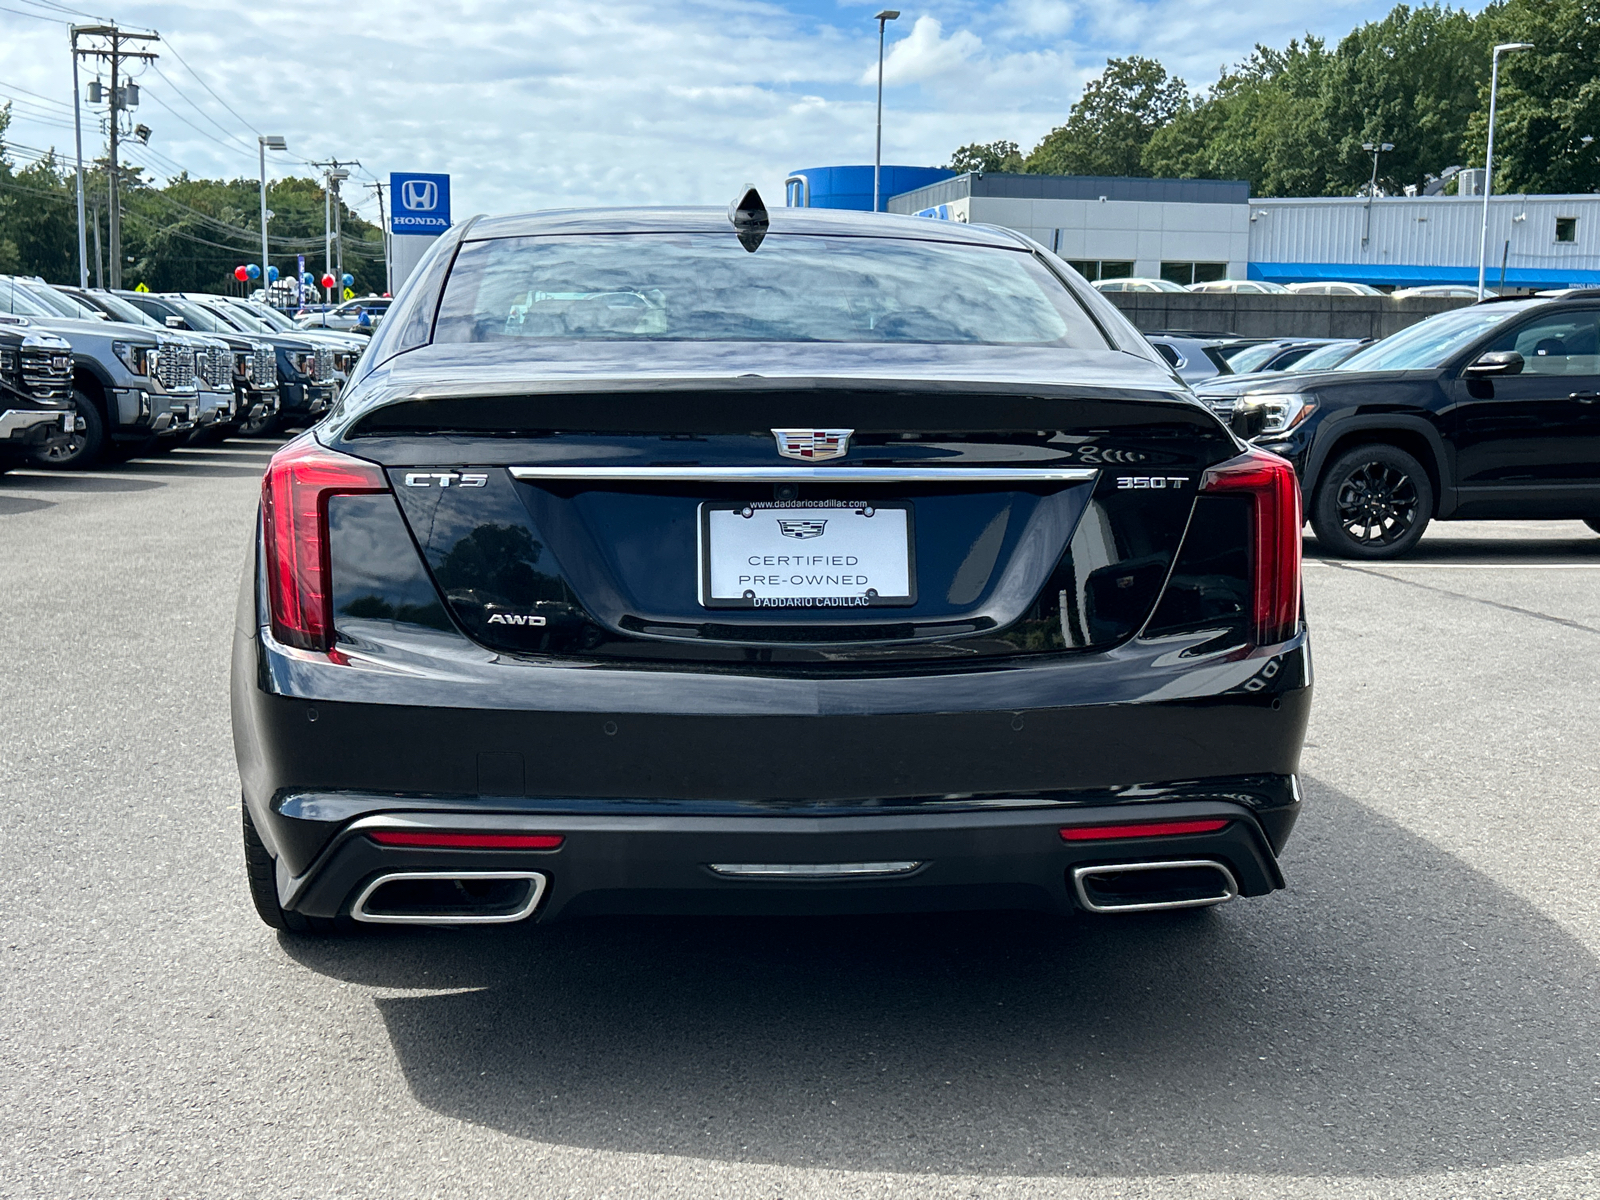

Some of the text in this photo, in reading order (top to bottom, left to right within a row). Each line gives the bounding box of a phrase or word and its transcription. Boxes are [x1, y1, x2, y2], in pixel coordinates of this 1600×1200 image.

[393, 217, 448, 226] HONDA
[1116, 477, 1190, 489] 350T
[750, 499, 868, 509] www.daddariocadillac.com
[748, 556, 858, 566] CERTIFIED
[739, 575, 868, 586] PRE-OWNED
[753, 596, 870, 608] D'ADDARIO CADILLAC
[487, 613, 547, 627] AWD
